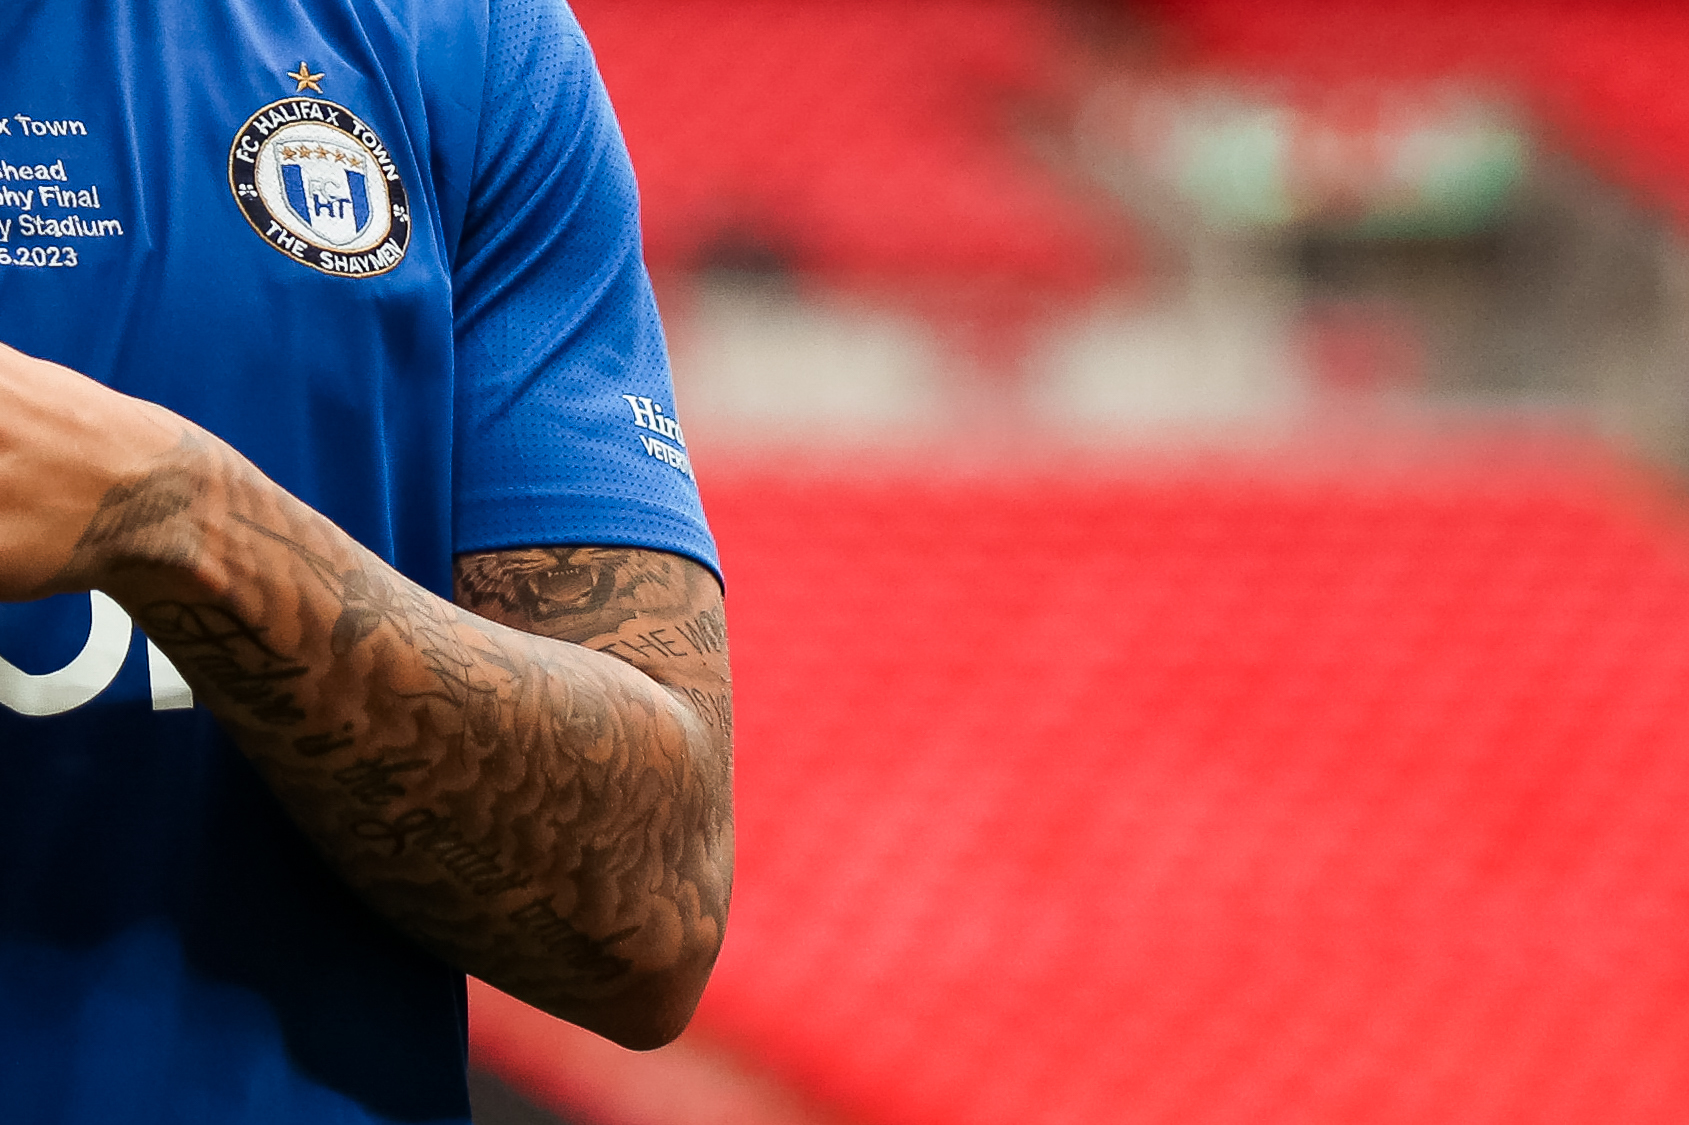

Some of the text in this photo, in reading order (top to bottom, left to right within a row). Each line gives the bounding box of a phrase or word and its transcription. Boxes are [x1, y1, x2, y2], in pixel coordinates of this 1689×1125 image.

[14, 113, 87, 137] Town
[236, 102, 399, 182] FC HALIFAX TOWN
[38, 185, 101, 209] Final
[17, 214, 124, 238] Stadium
[265, 220, 405, 273] THE SHAYMEN
[598, 626, 688, 662] THE
